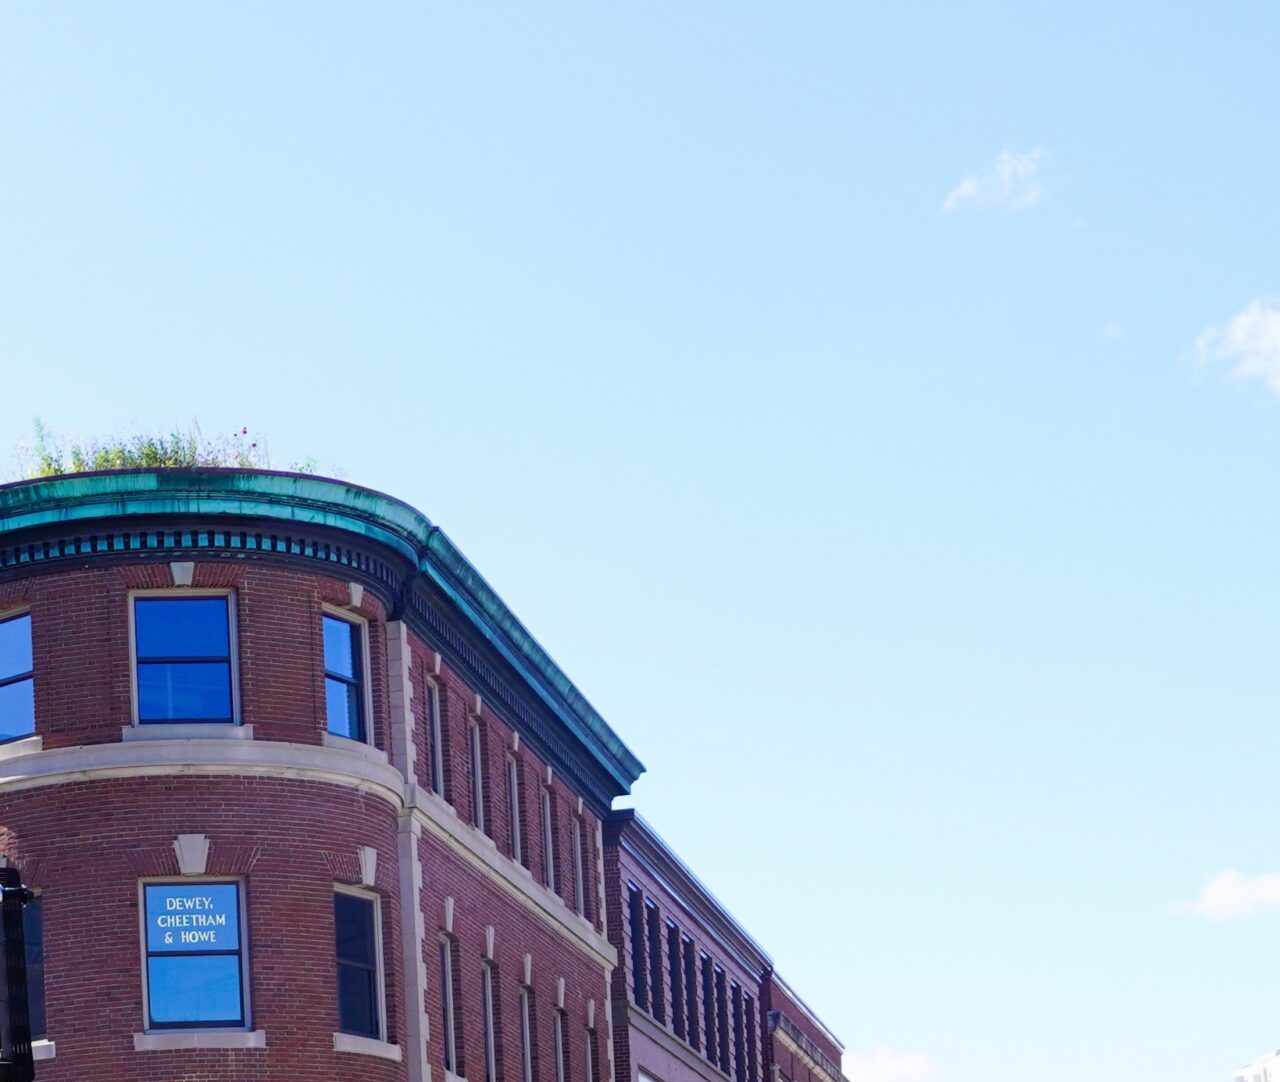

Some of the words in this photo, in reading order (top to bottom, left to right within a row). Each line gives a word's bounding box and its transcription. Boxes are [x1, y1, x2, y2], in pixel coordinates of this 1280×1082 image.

[166, 897, 214, 910] DEWEY,
[157, 913, 226, 928] CHEETHAM
[164, 931, 174, 944] &
[181, 930, 217, 943] HOWE
